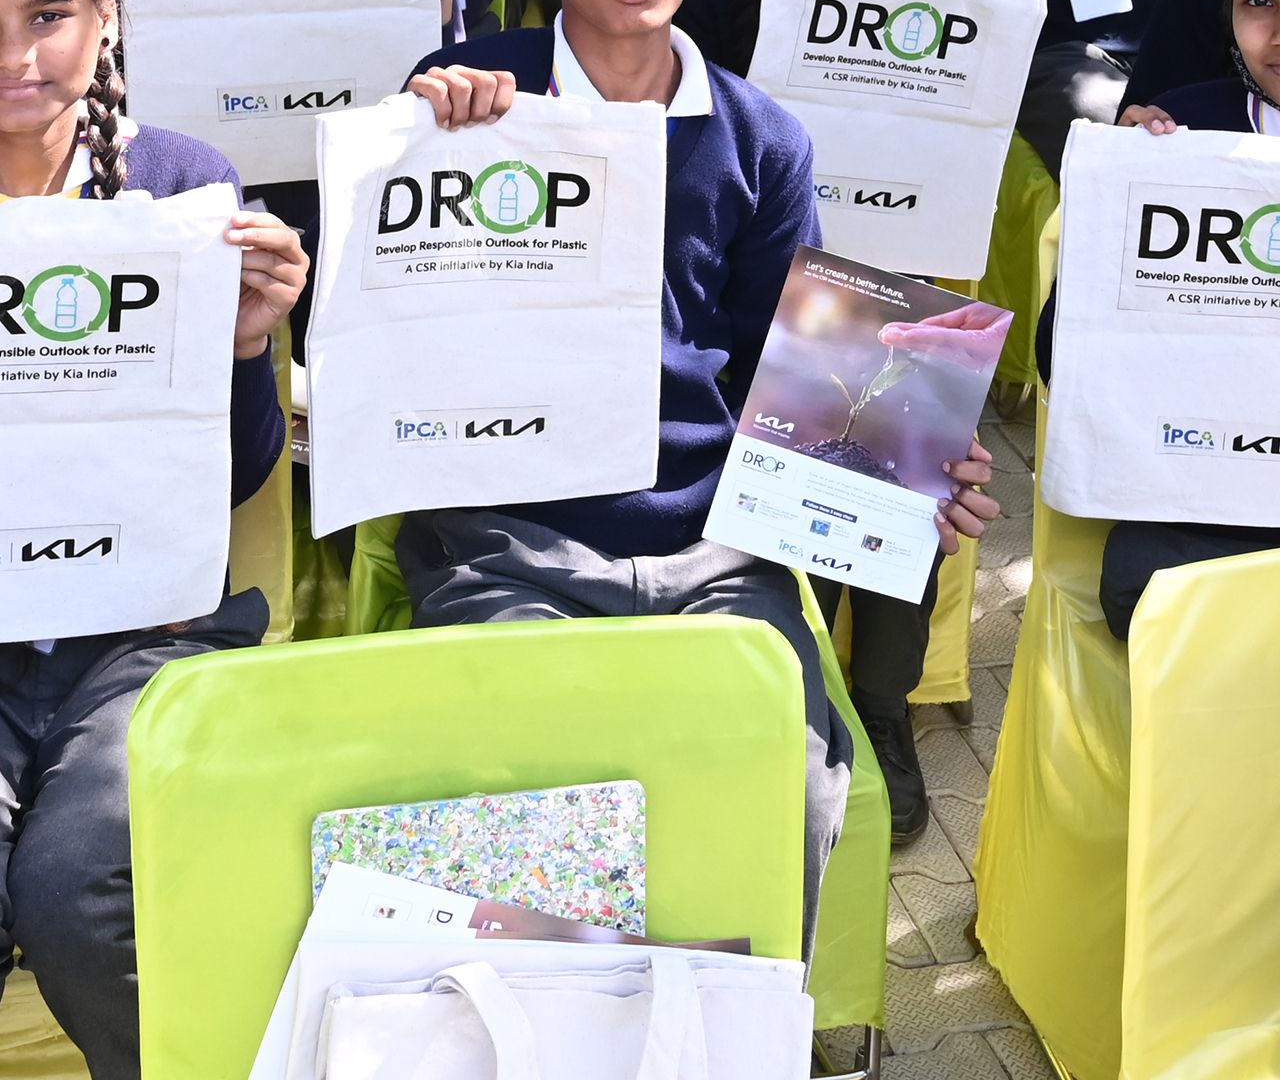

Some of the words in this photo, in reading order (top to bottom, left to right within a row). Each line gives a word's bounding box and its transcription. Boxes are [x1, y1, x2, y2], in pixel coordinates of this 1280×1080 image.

[377, 160, 591, 235] DROP
[375, 243, 417, 256] Develop
[419, 238, 483, 252] Responsible
[485, 237, 530, 248] Outlook
[532, 238, 550, 249] for
[551, 239, 588, 251] Plastic
[404, 264, 413, 274] A
[415, 261, 437, 273] CSR
[439, 260, 487, 271] initiative
[489, 259, 503, 271] by
[505, 259, 524, 270] Kia
[526, 260, 554, 271] India
[806, 261, 825, 273] Let's
[825, 269, 849, 281] create
[856, 277, 879, 291] better
[880, 285, 905, 300] future.
[1135, 269, 1181, 284] Develop
[1183, 272, 1249, 286] Responsible
[1166, 293, 1176, 303] A
[1178, 293, 1201, 304] CSR
[1203, 295, 1251, 307] initiative
[1253, 297, 1268, 309] by
[39, 345, 90, 357] Outlook
[93, 344, 112, 356] for
[115, 343, 156, 355] Plastic
[43, 369, 60, 382] by
[63, 368, 84, 379] Kia
[86, 368, 118, 379] India
[742, 450, 786, 474] DROP
